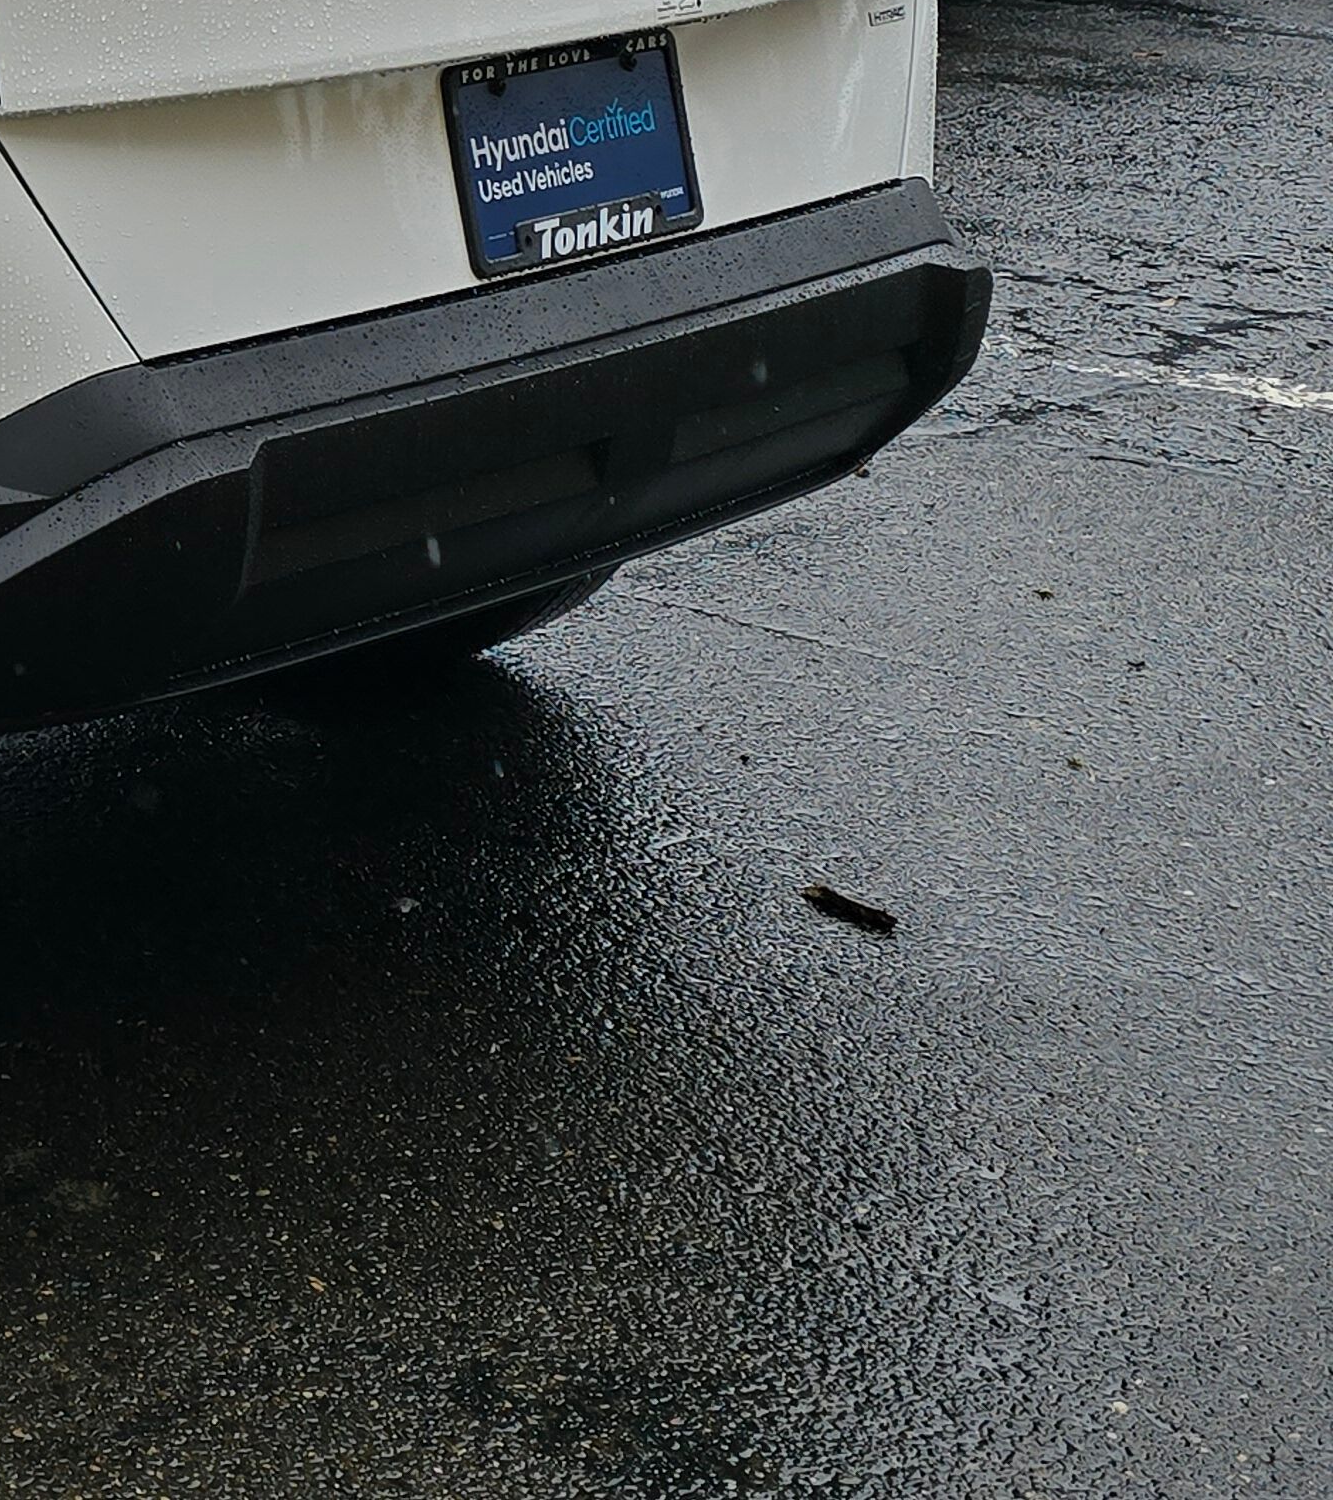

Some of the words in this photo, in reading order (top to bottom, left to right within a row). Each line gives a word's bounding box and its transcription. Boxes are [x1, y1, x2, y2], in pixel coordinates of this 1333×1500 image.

[461, 66, 495, 84] FOR
[506, 56, 539, 76] THE
[548, 49, 591, 68] LOVE
[625, 33, 669, 53] CARS
[469, 118, 570, 172] Hyundai
[569, 97, 657, 148] Certified
[477, 170, 524, 203] Used
[523, 160, 594, 193] Vehicles
[533, 203, 654, 260] Tonkin
